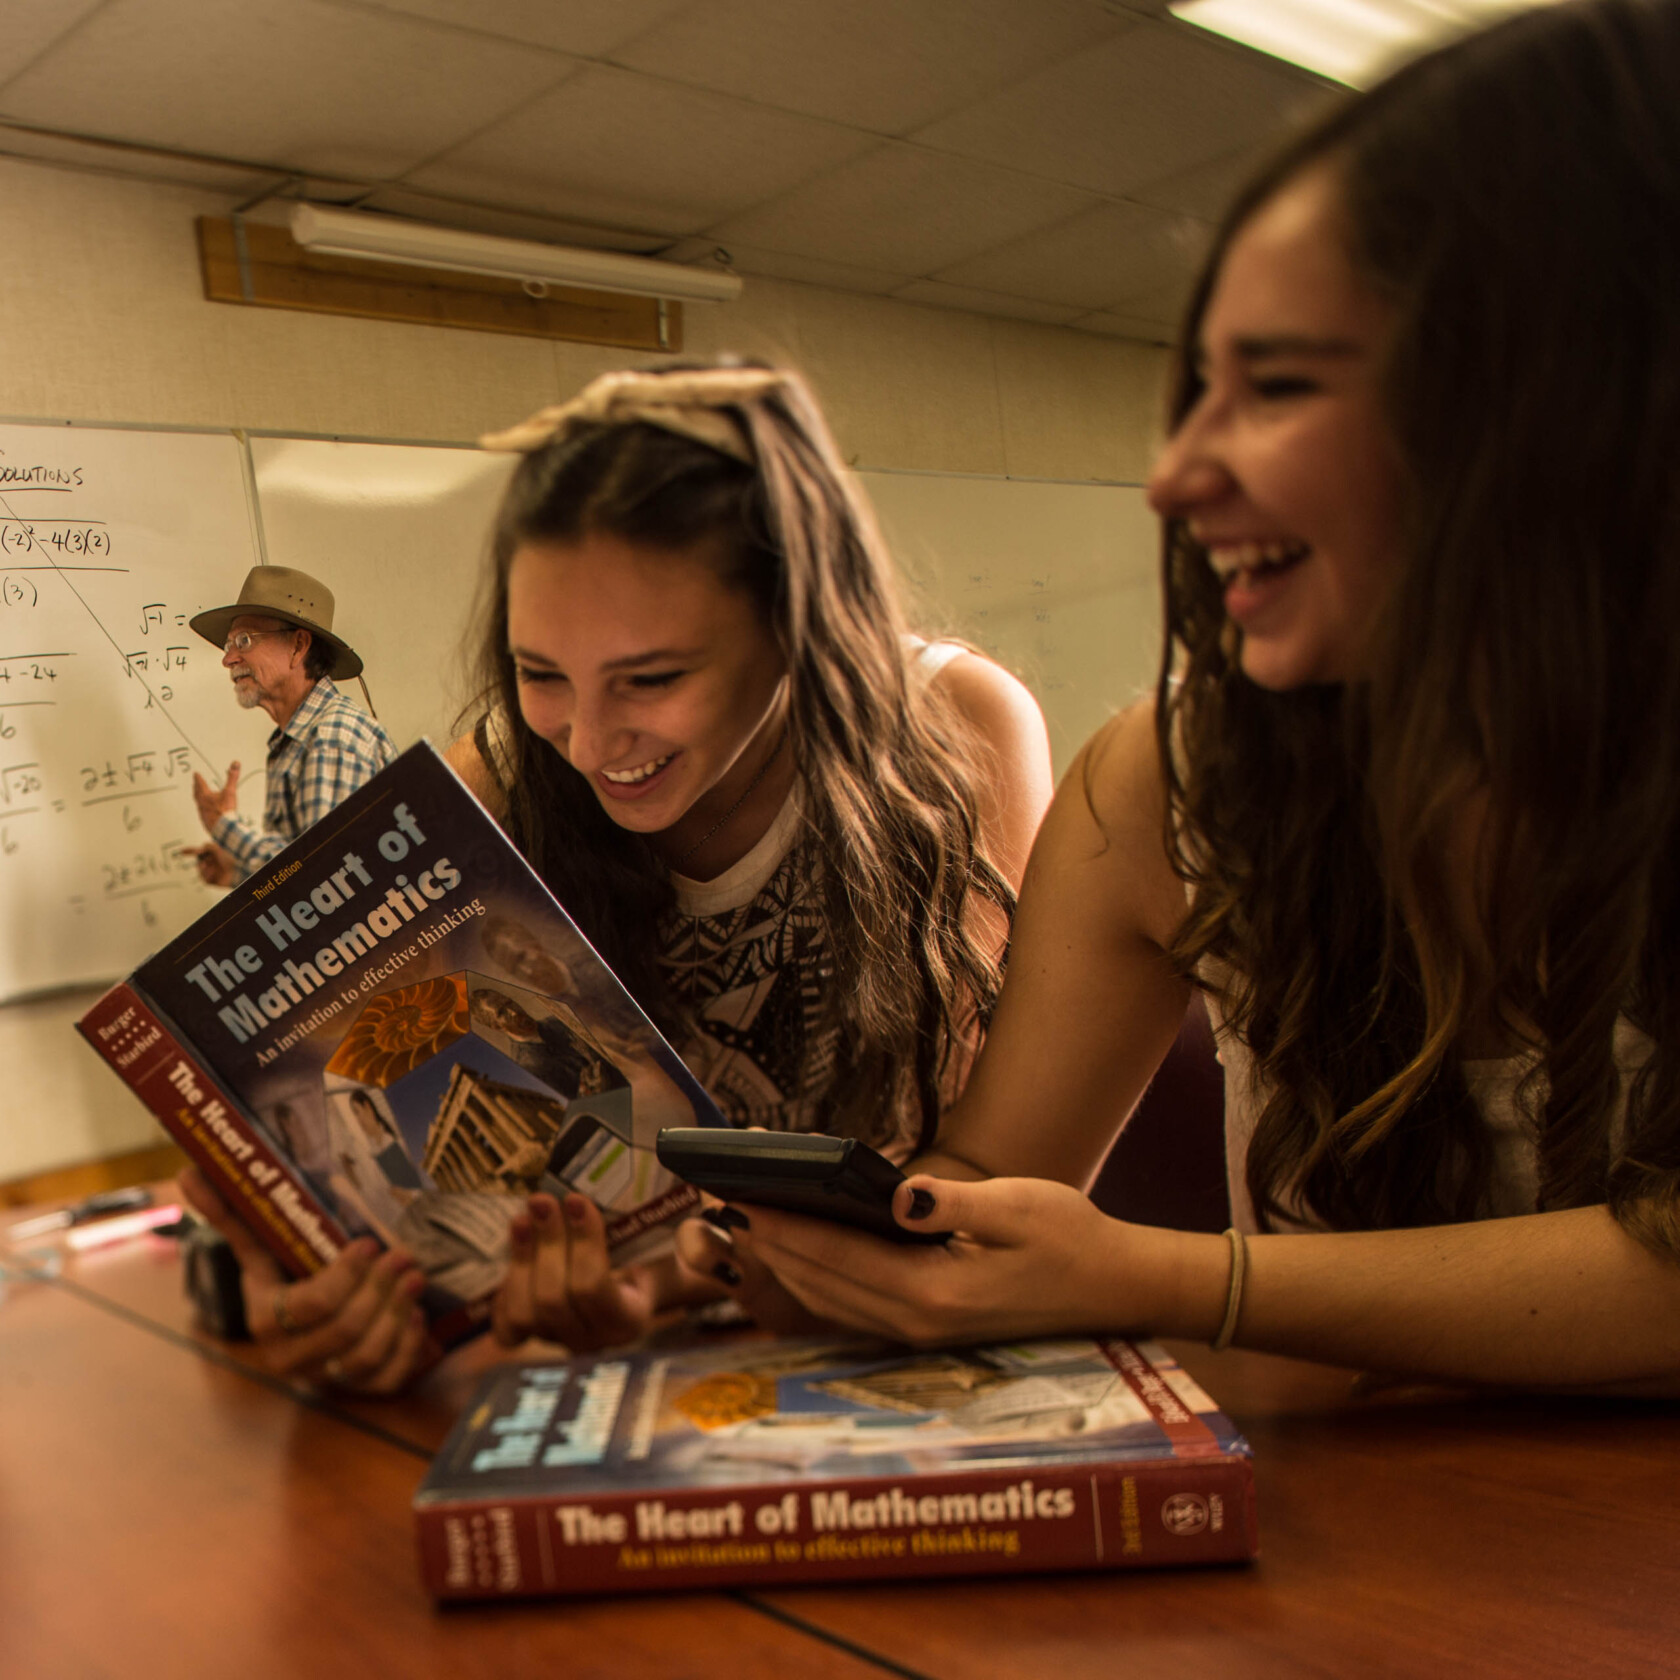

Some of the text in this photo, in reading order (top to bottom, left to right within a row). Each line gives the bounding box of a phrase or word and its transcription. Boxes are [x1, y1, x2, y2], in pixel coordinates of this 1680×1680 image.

[184, 802, 427, 1003] The Heart of
[252, 859, 303, 902] Third Edition
[217, 857, 462, 1044] Mathematics
[255, 897, 487, 1068] An invitation to effective thinking
[168, 1061, 203, 1105] The
[200, 1099, 254, 1161] Heart
[249, 1161, 280, 1187] of
[556, 1479, 1076, 1545] The Heart of Mathematics
[911, 1526, 1021, 1558] thinking
